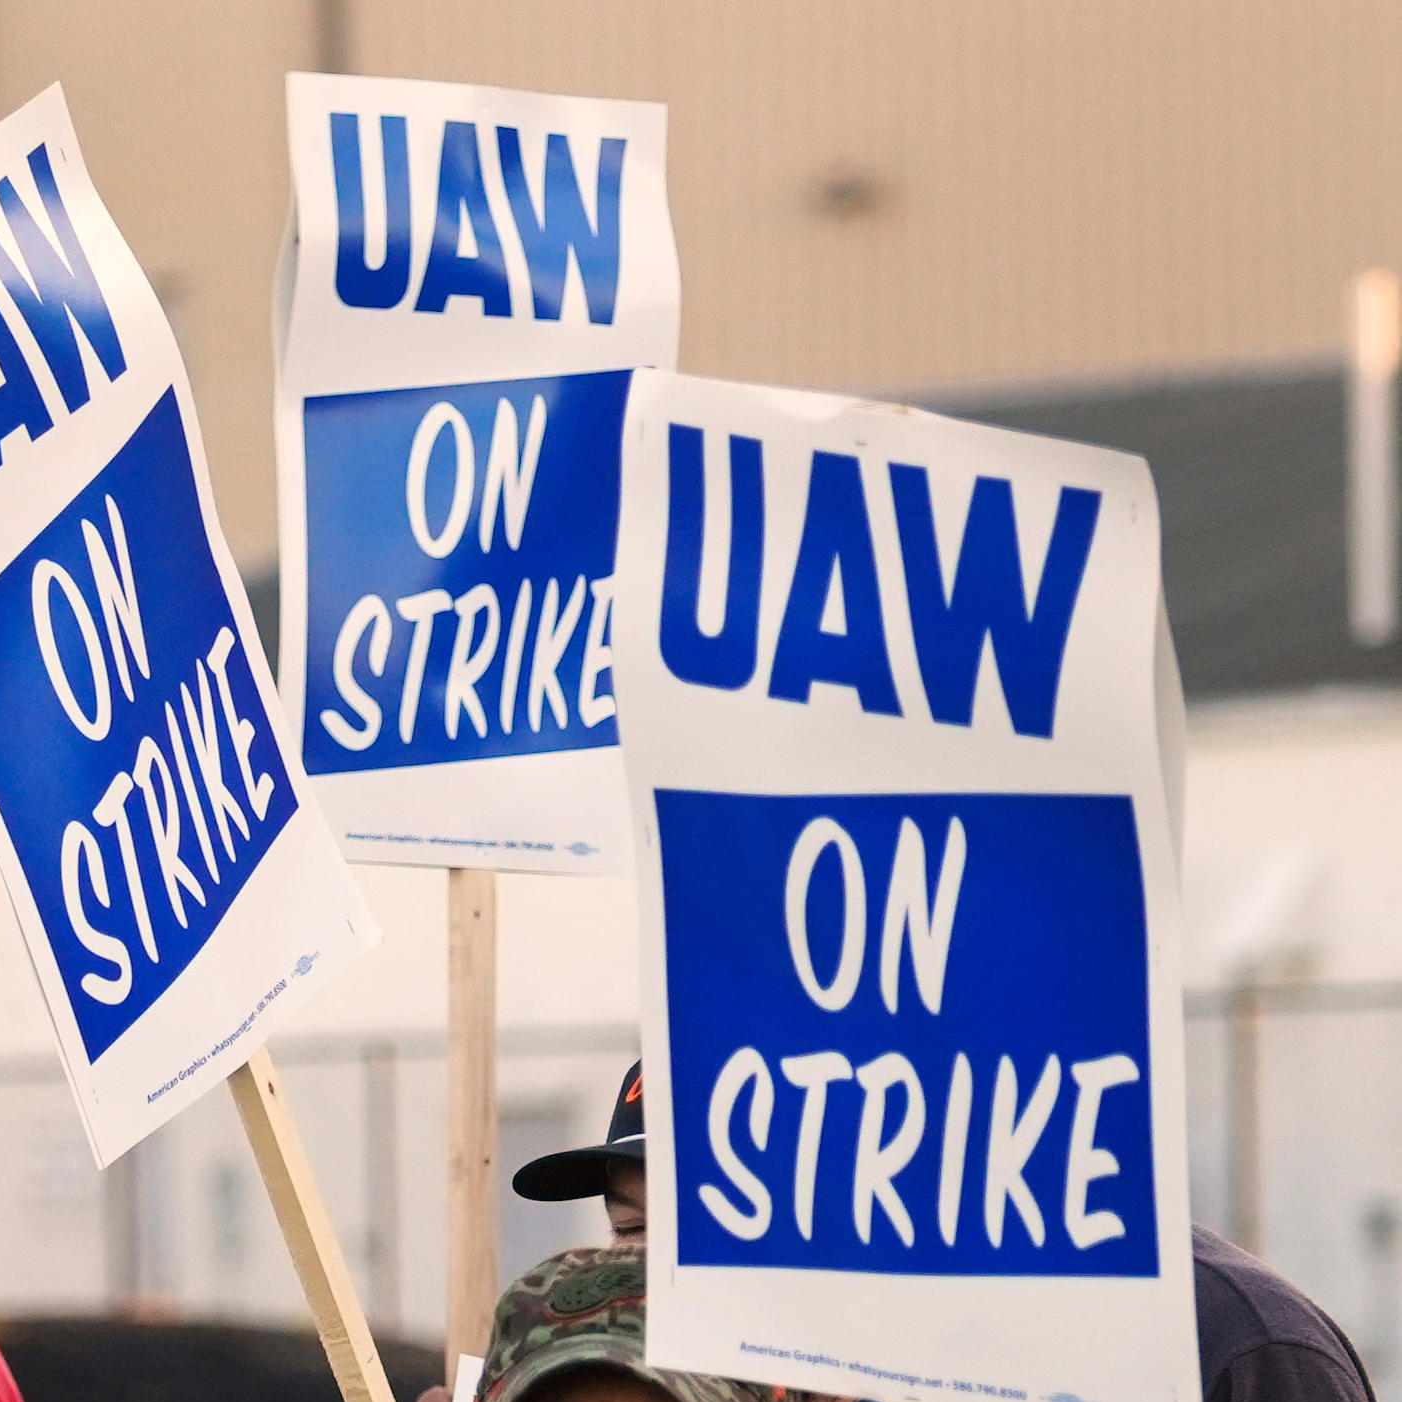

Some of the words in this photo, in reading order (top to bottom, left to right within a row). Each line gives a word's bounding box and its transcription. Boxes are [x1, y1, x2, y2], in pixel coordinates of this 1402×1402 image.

[329, 112, 627, 327] UAW
[405, 393, 548, 560] ON
[31, 493, 151, 742] ON
[319, 573, 617, 752] STRIKE
[658, 422, 1102, 741] UAW
[60, 625, 276, 1006] STRIKE
[784, 817, 967, 1015] ON
[146, 1076, 179, 1105] American
[177, 1055, 208, 1081] Graphics
[698, 1046, 1140, 1250] STRIKE
[740, 1341, 792, 1359] American
[793, 1349, 841, 1369] Graphics
[848, 1358, 944, 1390] whatsyoursign.net
[952, 1378, 1029, 1401] 586.790.8500
